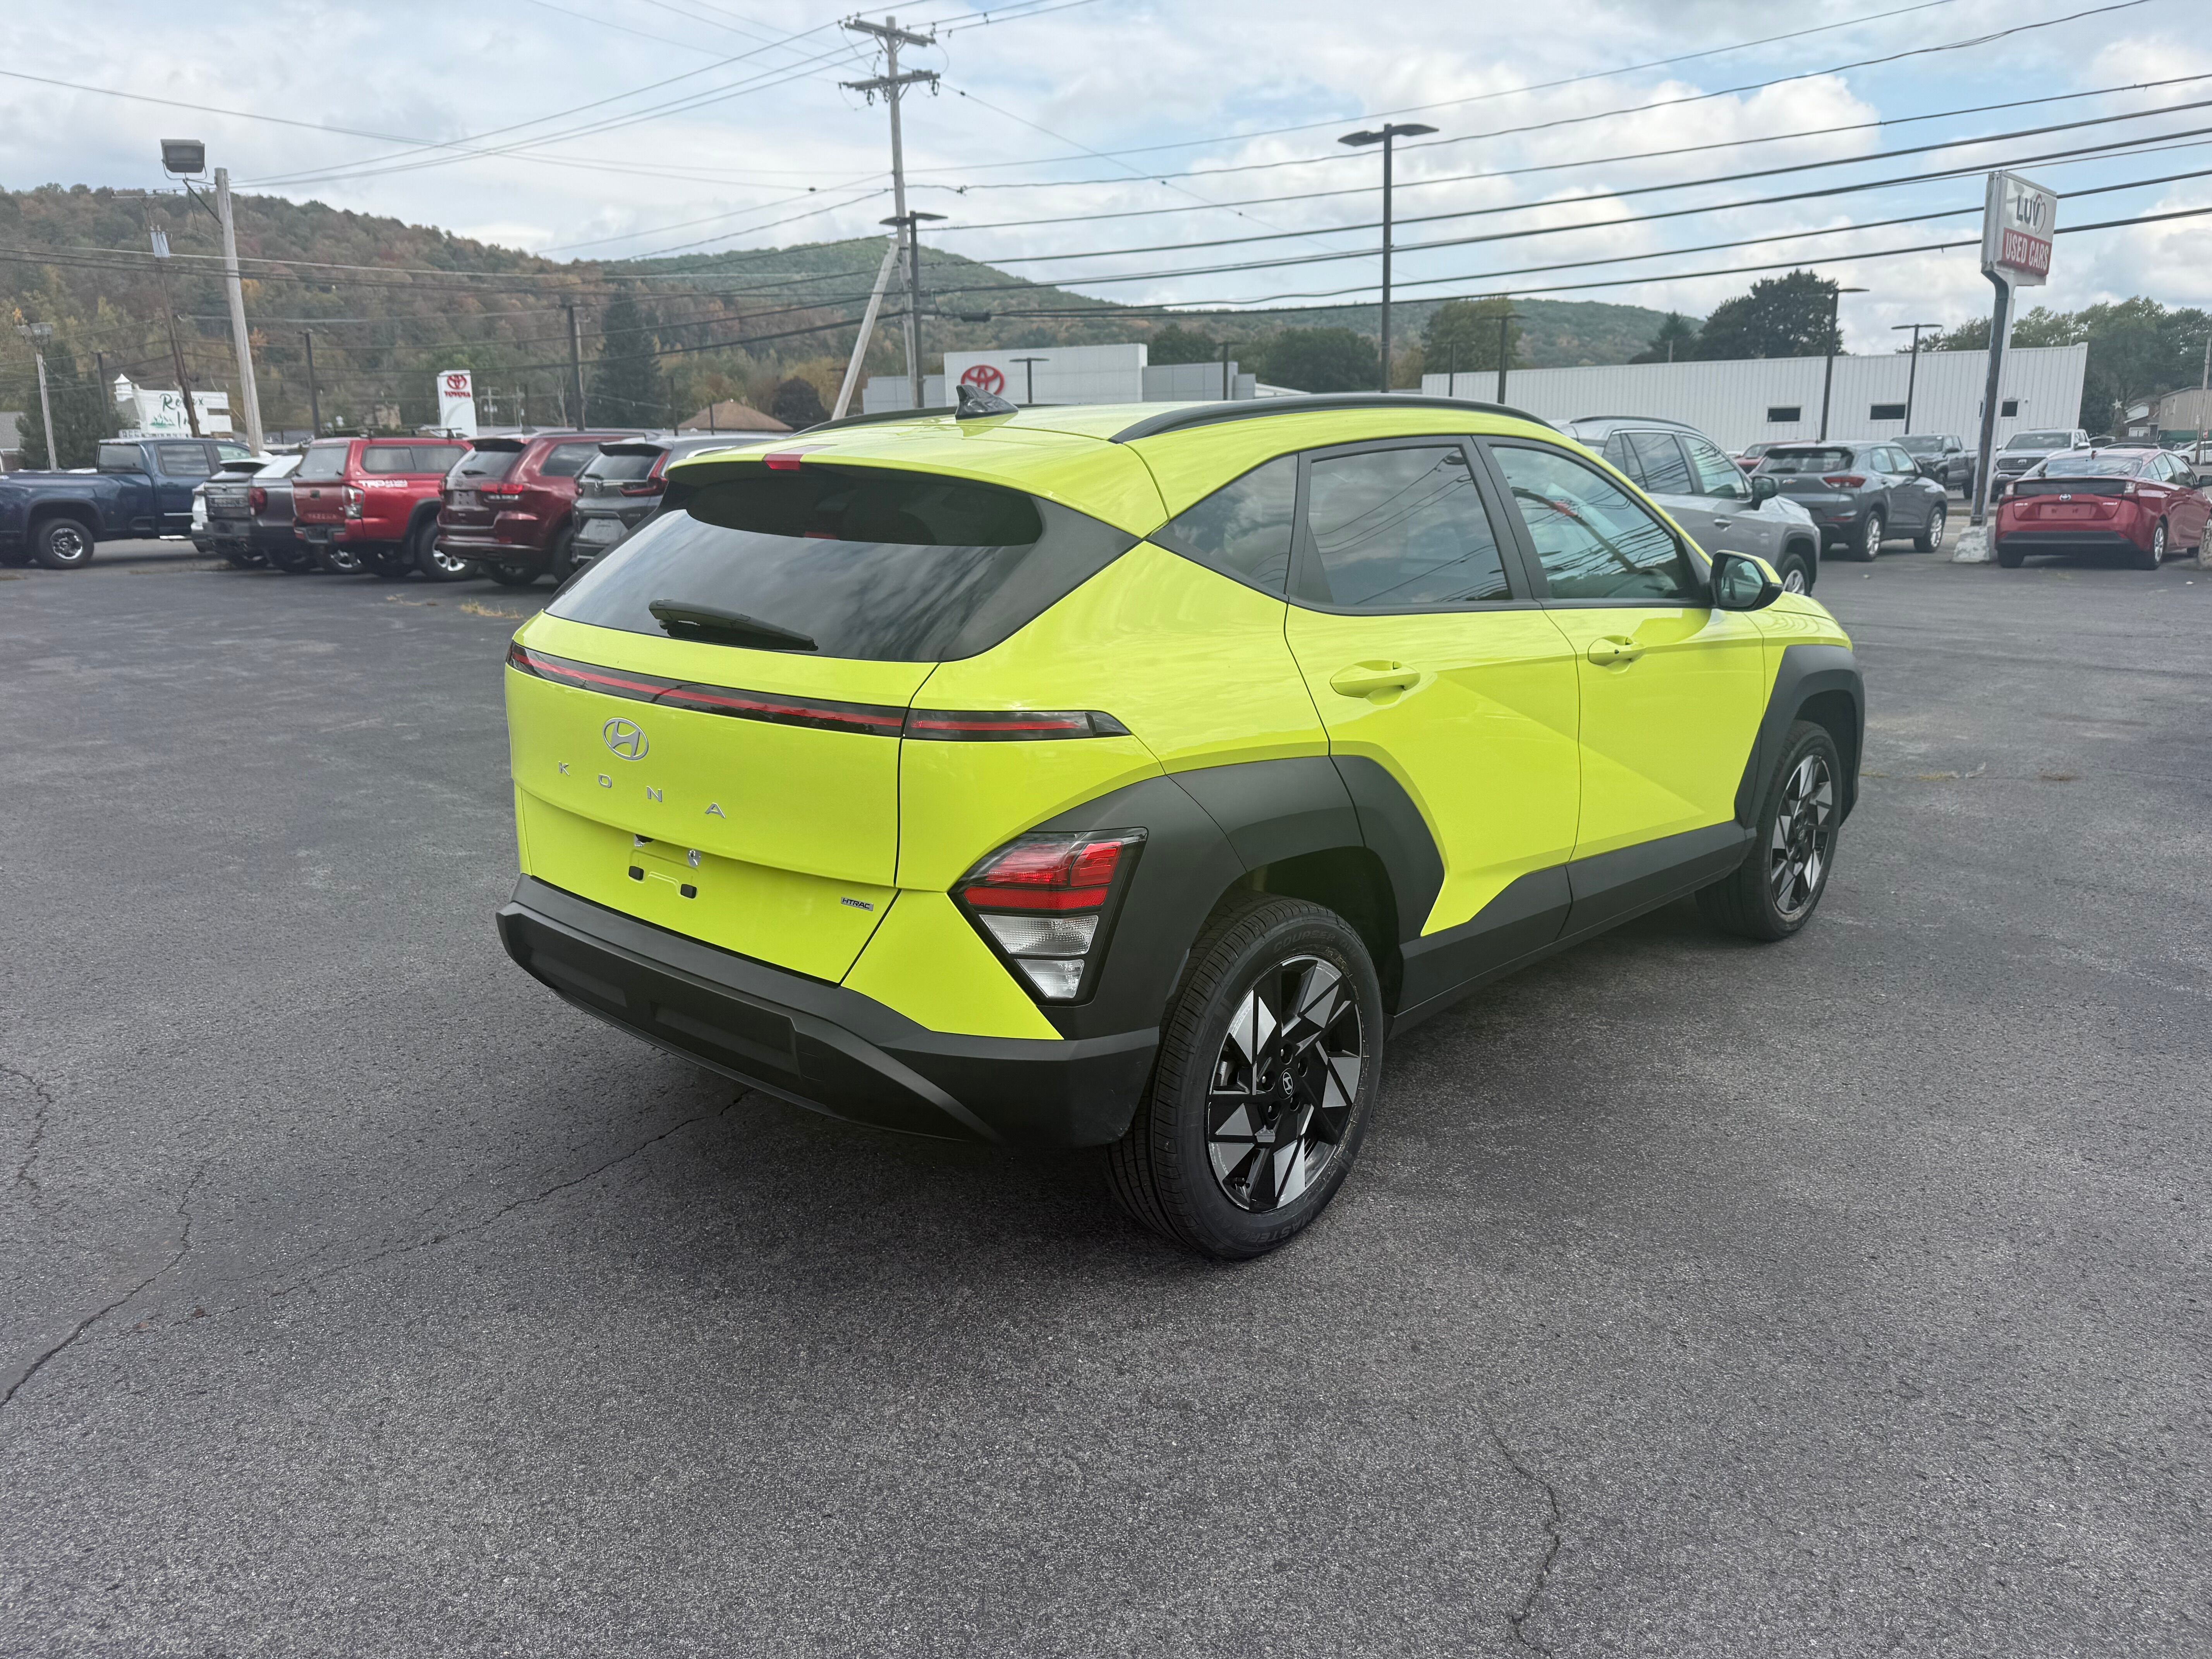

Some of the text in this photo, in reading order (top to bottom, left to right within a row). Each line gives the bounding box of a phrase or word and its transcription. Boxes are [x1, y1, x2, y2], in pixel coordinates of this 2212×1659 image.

[2006, 233, 2049, 270] USED CARS
[160, 393, 204, 411] Rex
[558, 761, 726, 819] KONA
[842, 898, 870, 909] HTRAC
